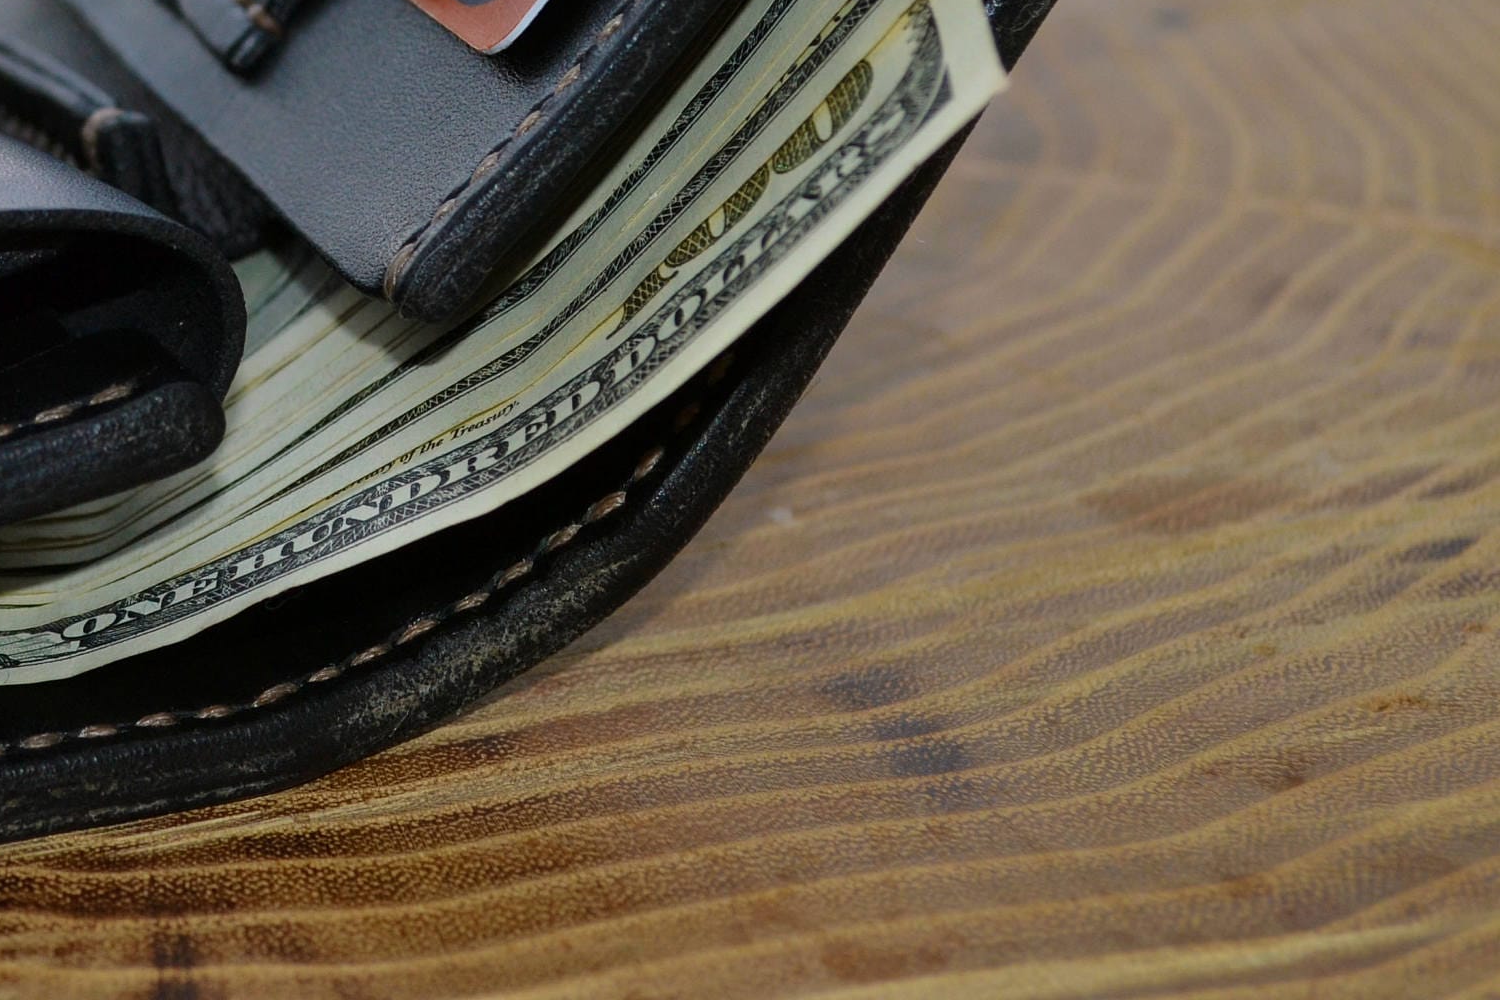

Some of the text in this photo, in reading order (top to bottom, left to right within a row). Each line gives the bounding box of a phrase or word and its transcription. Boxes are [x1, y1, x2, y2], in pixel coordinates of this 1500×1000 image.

[61, 103, 906, 638] ONE HUNDRED DOLLARS
[419, 437, 445, 455] the
